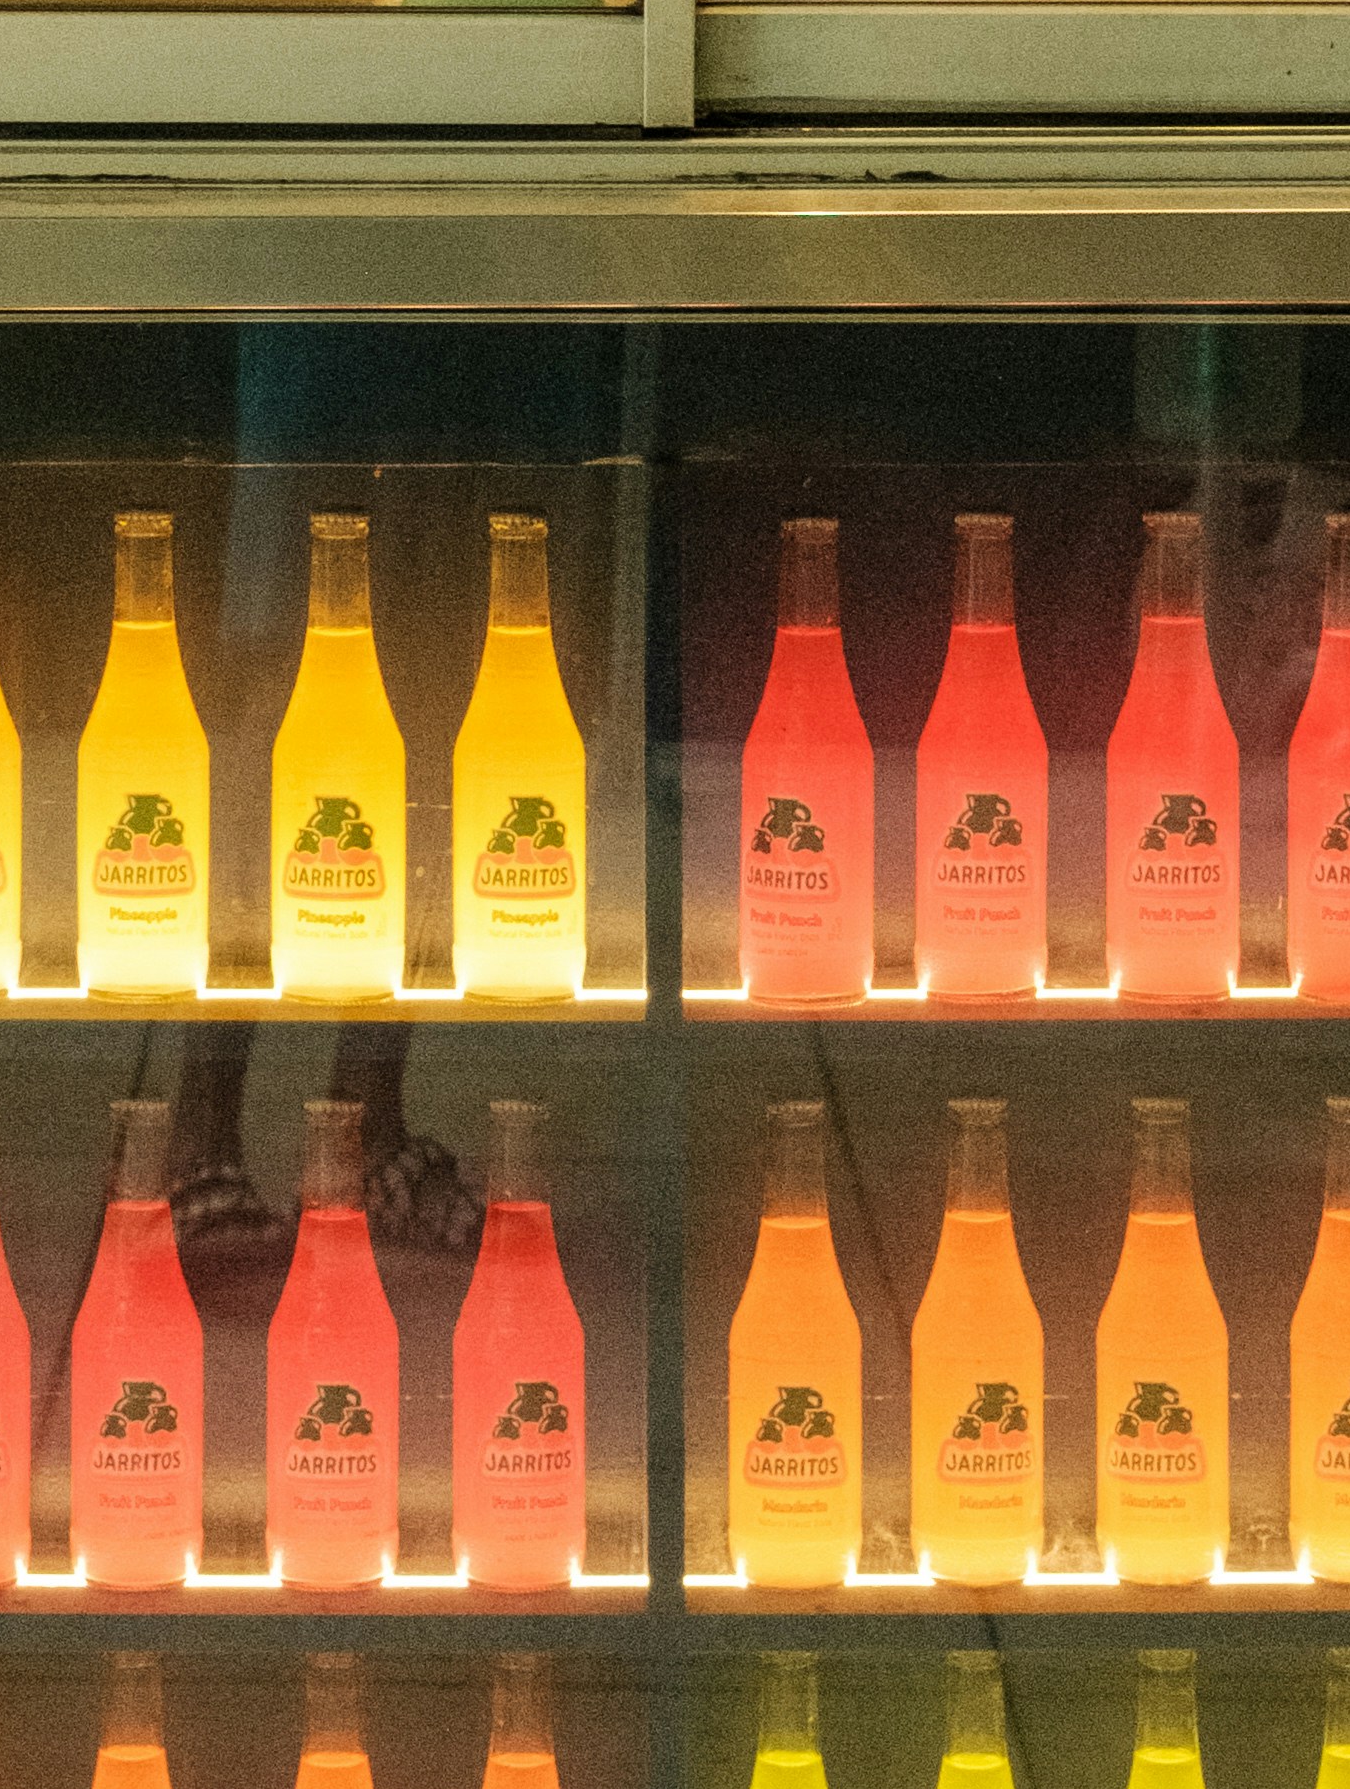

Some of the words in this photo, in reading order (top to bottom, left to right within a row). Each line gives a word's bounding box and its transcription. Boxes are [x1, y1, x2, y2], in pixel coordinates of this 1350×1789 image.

[101, 864, 187, 883] JARRITOS
[289, 867, 376, 887] JARRITOS
[481, 867, 568, 887] JARRITOS
[748, 866, 828, 890] JARRITOS
[939, 864, 1025, 884] JARRITOS
[1133, 865, 1220, 884] JARRITOS
[110, 907, 177, 922] Pineapple
[298, 910, 365, 925] Pineapple
[492, 910, 559, 925] Pineapple
[94, 1451, 180, 1471] JARRITOS
[289, 1454, 376, 1474] JARRITOS
[486, 1451, 571, 1472] JARRITOS
[751, 1456, 838, 1476] JARRITOS
[946, 1451, 1031, 1472] JARRITOS
[1111, 1451, 1196, 1471] JARRITOS
